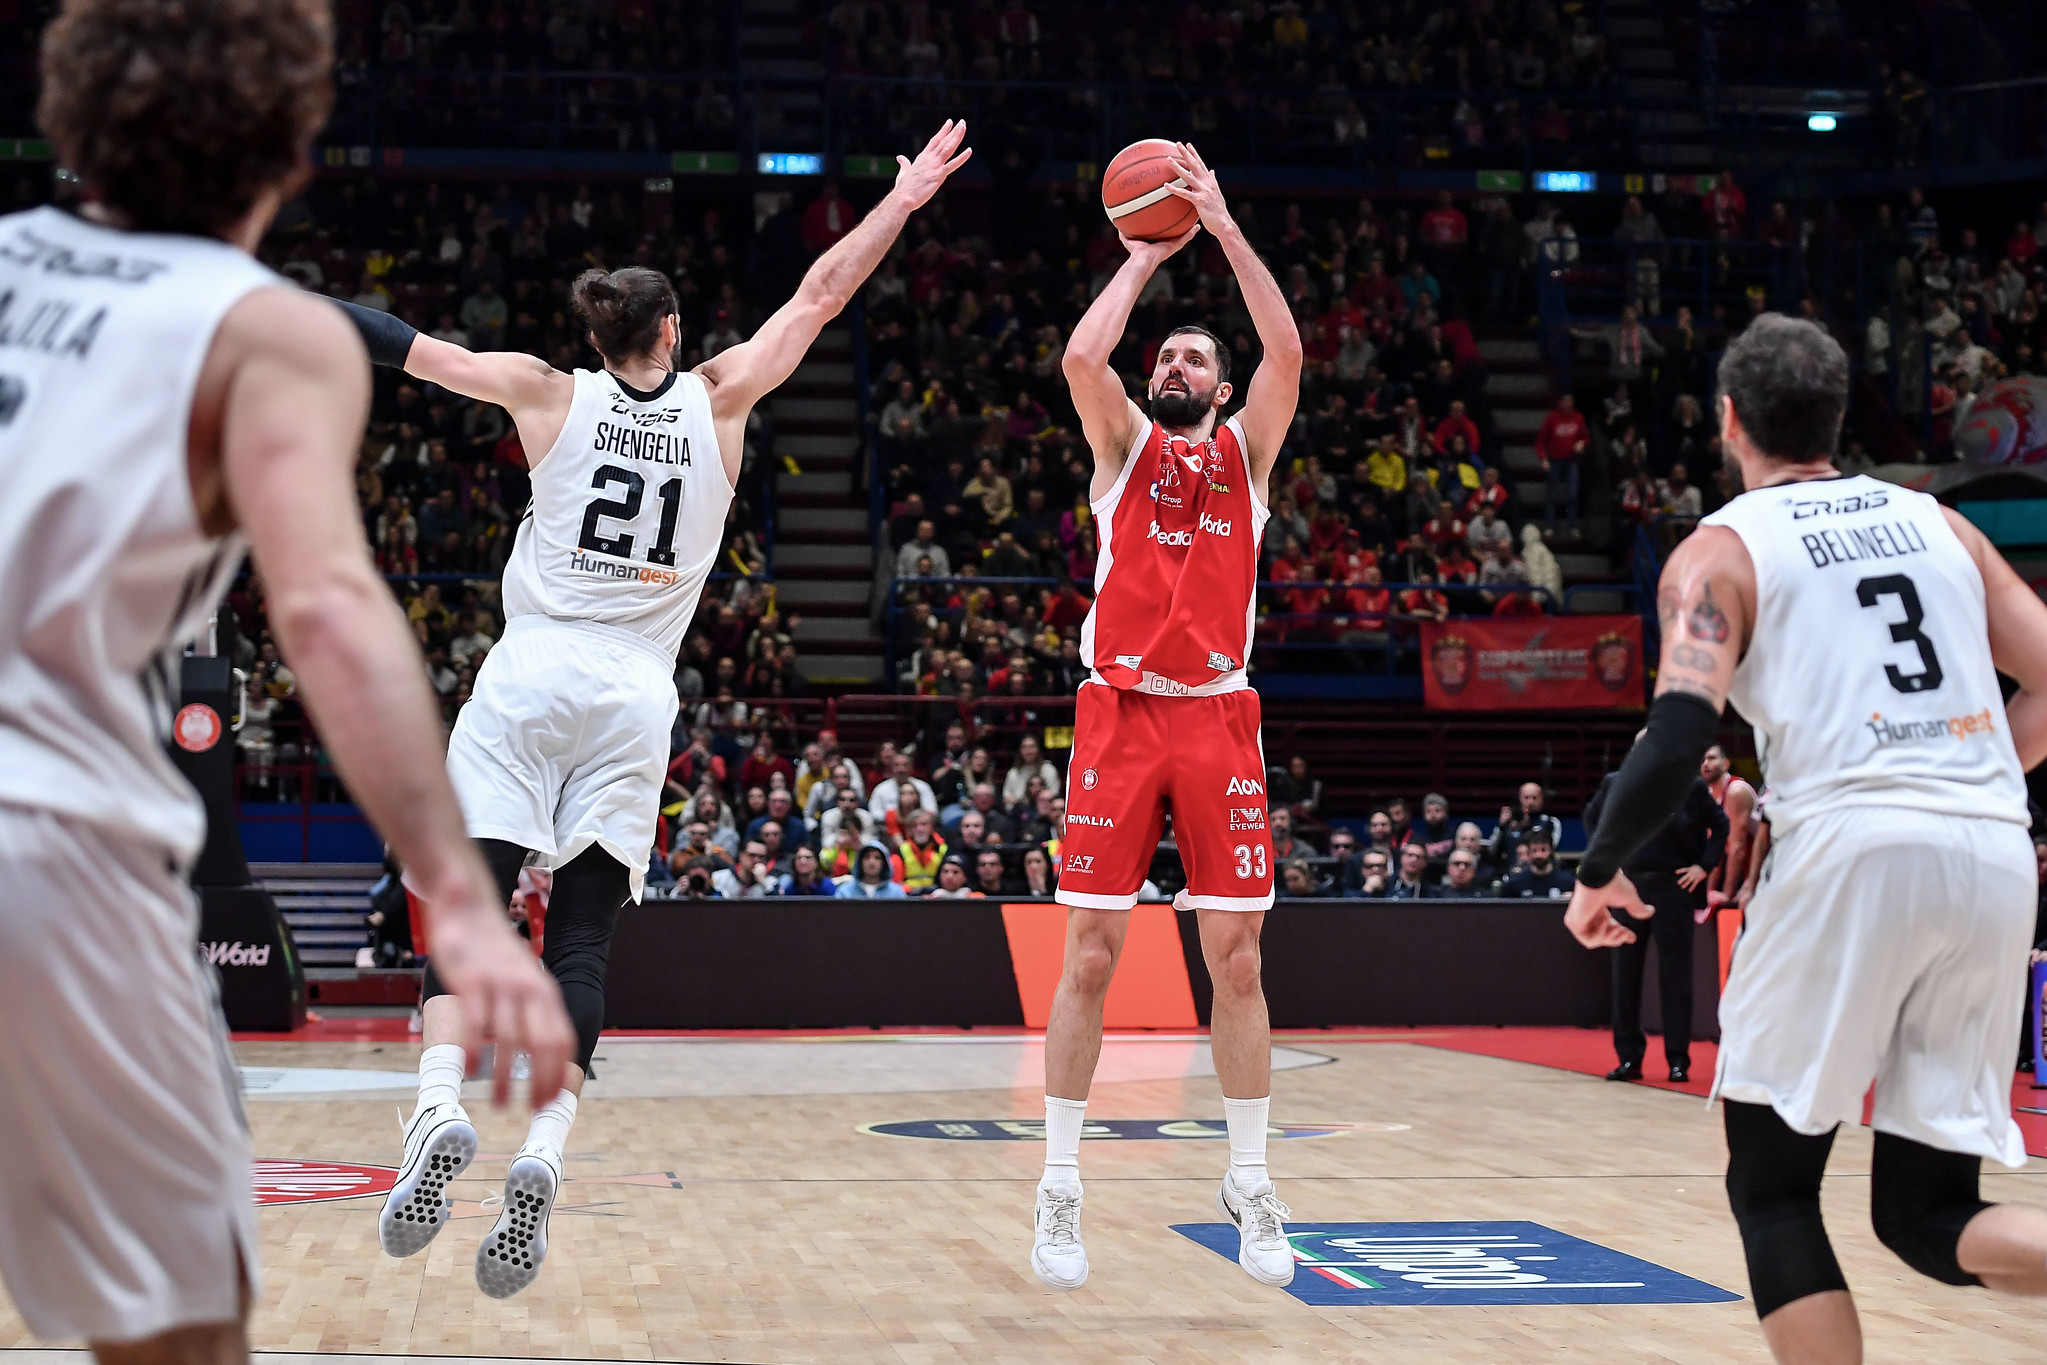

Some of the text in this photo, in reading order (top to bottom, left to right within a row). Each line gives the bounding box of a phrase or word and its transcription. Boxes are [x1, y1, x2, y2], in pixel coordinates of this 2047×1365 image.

[594, 421, 692, 467] SHENGELIA
[578, 464, 685, 567] 21
[1161, 493, 1182, 505] Group
[1801, 520, 1927, 569] BELINELLI
[570, 549, 679, 585] Humangest
[1856, 573, 1943, 693] 3
[1151, 674, 1189, 695] OM
[1866, 709, 1996, 744] Humangest
[1230, 822, 1265, 831] EYEWEAR
[1234, 843, 1267, 879] 33
[208, 941, 270, 966] World
[1297, 1234, 1646, 1290] Unipol
